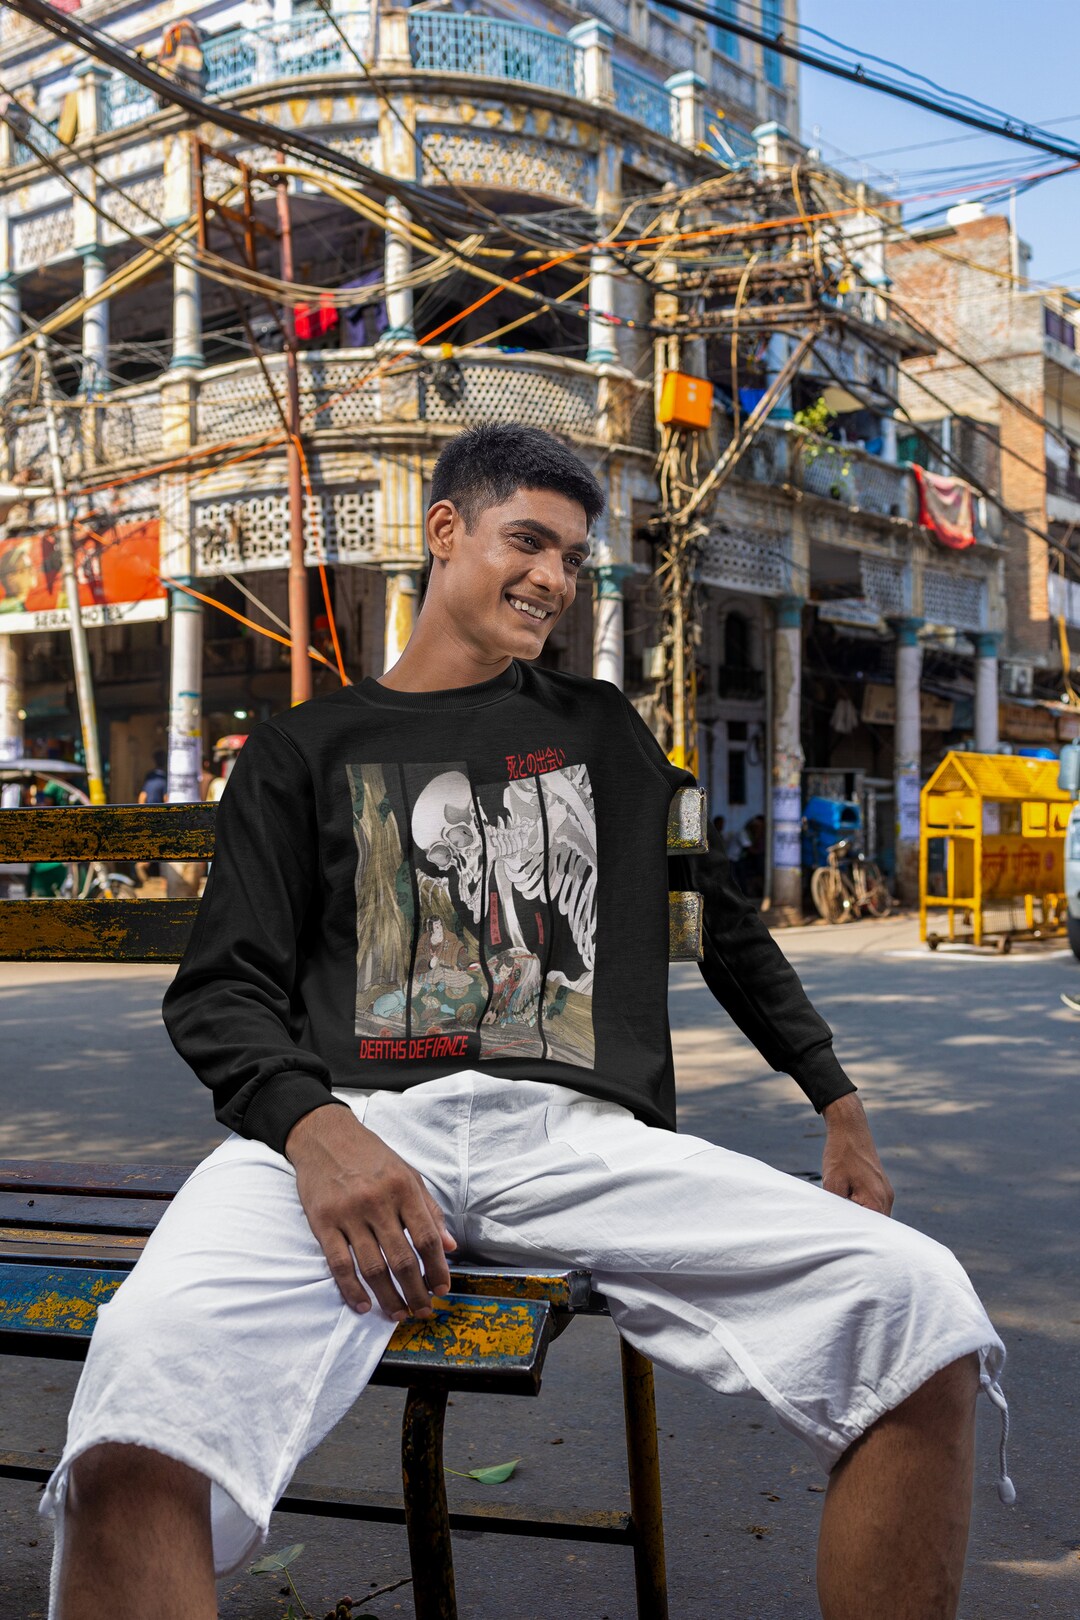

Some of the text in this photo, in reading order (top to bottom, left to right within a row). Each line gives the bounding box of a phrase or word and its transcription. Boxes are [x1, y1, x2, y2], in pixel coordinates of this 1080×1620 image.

[505, 746, 566, 780] 死との出会い
[360, 1035, 469, 1060] DEATHS DEFIANCE
